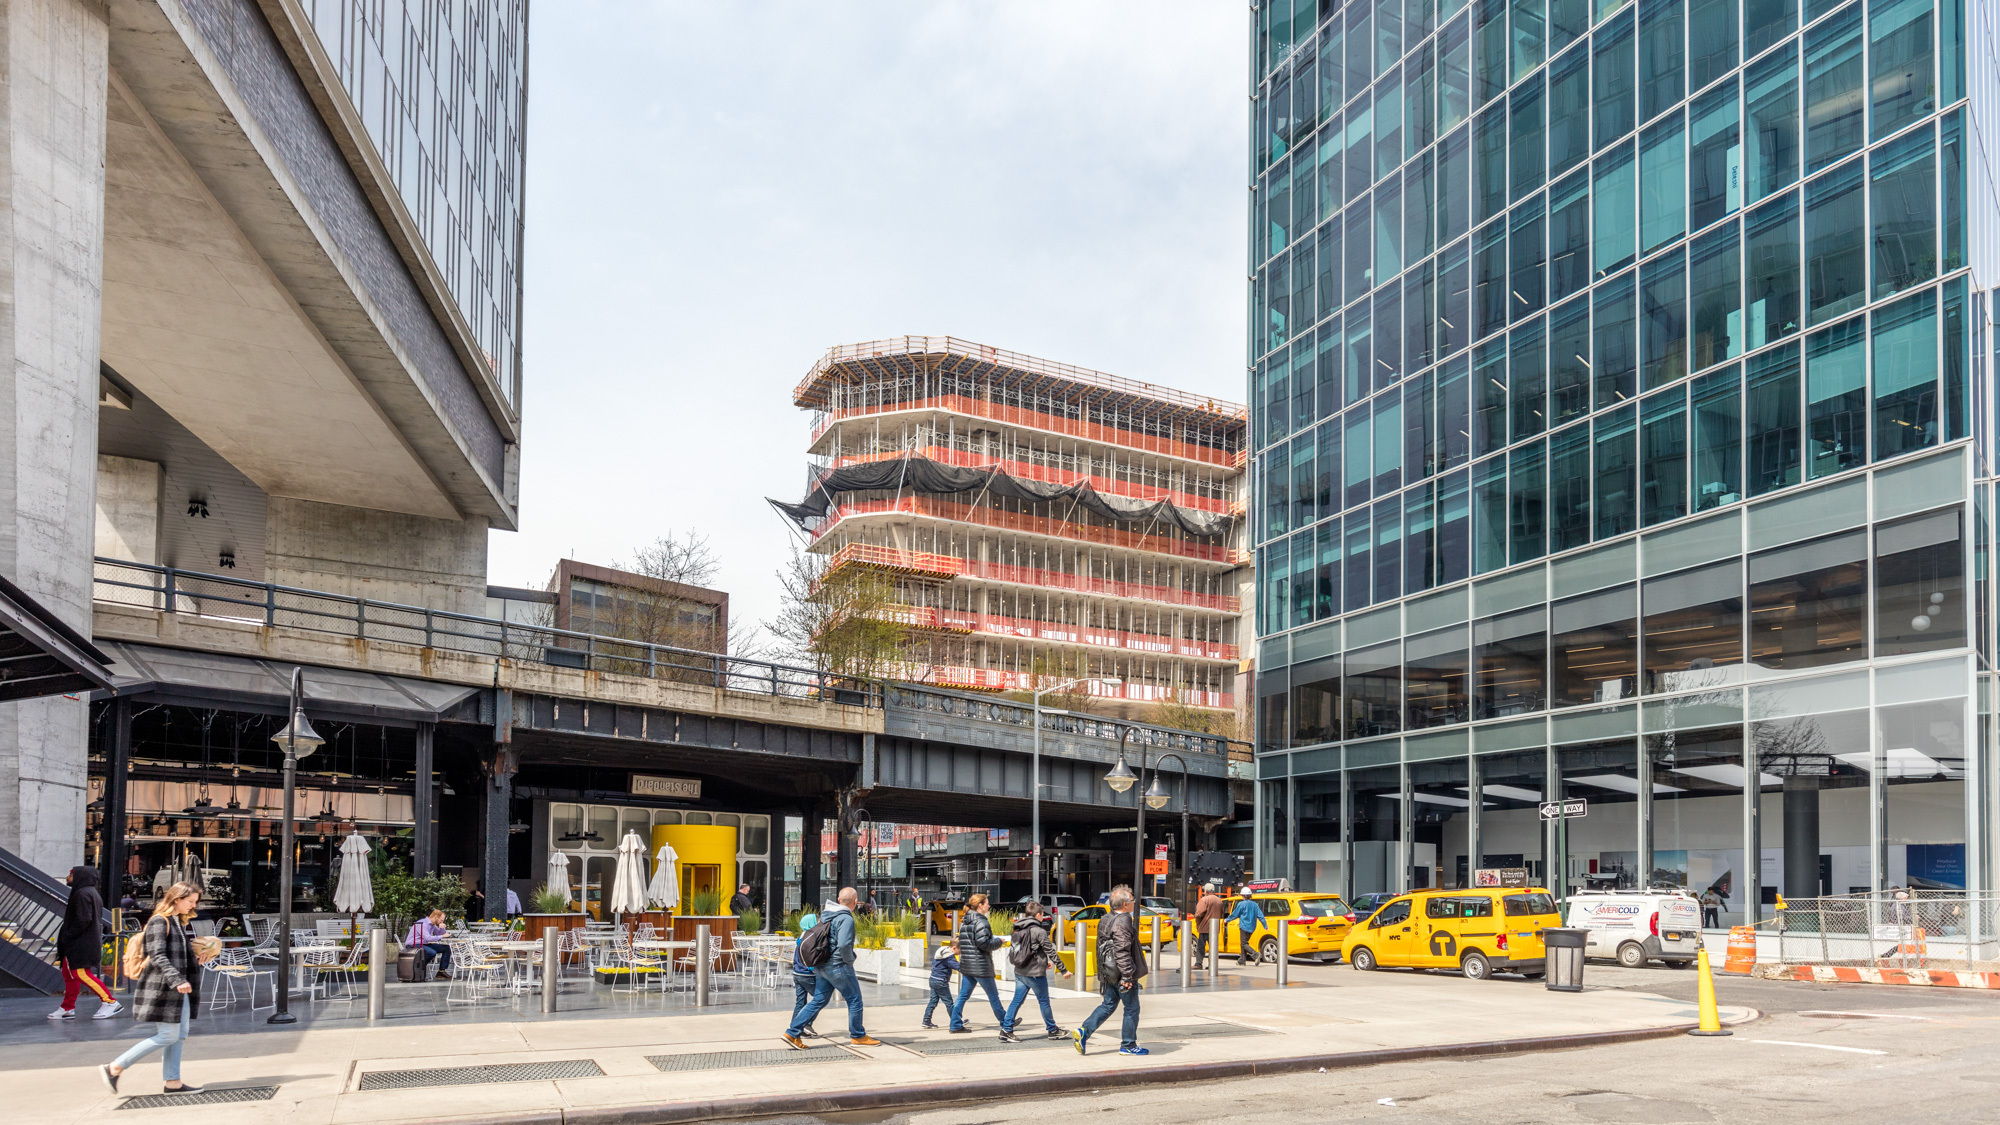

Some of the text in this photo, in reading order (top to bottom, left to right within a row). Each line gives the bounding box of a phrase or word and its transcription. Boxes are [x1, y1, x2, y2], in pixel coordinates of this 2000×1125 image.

[636, 779, 698, 795] The Standard
[1545, 804, 1582, 815] ONE WAY
[1596, 906, 1640, 915] AMERICOLD
[1672, 905, 1697, 913] AMERICOLD
[1434, 936, 1451, 956] T
